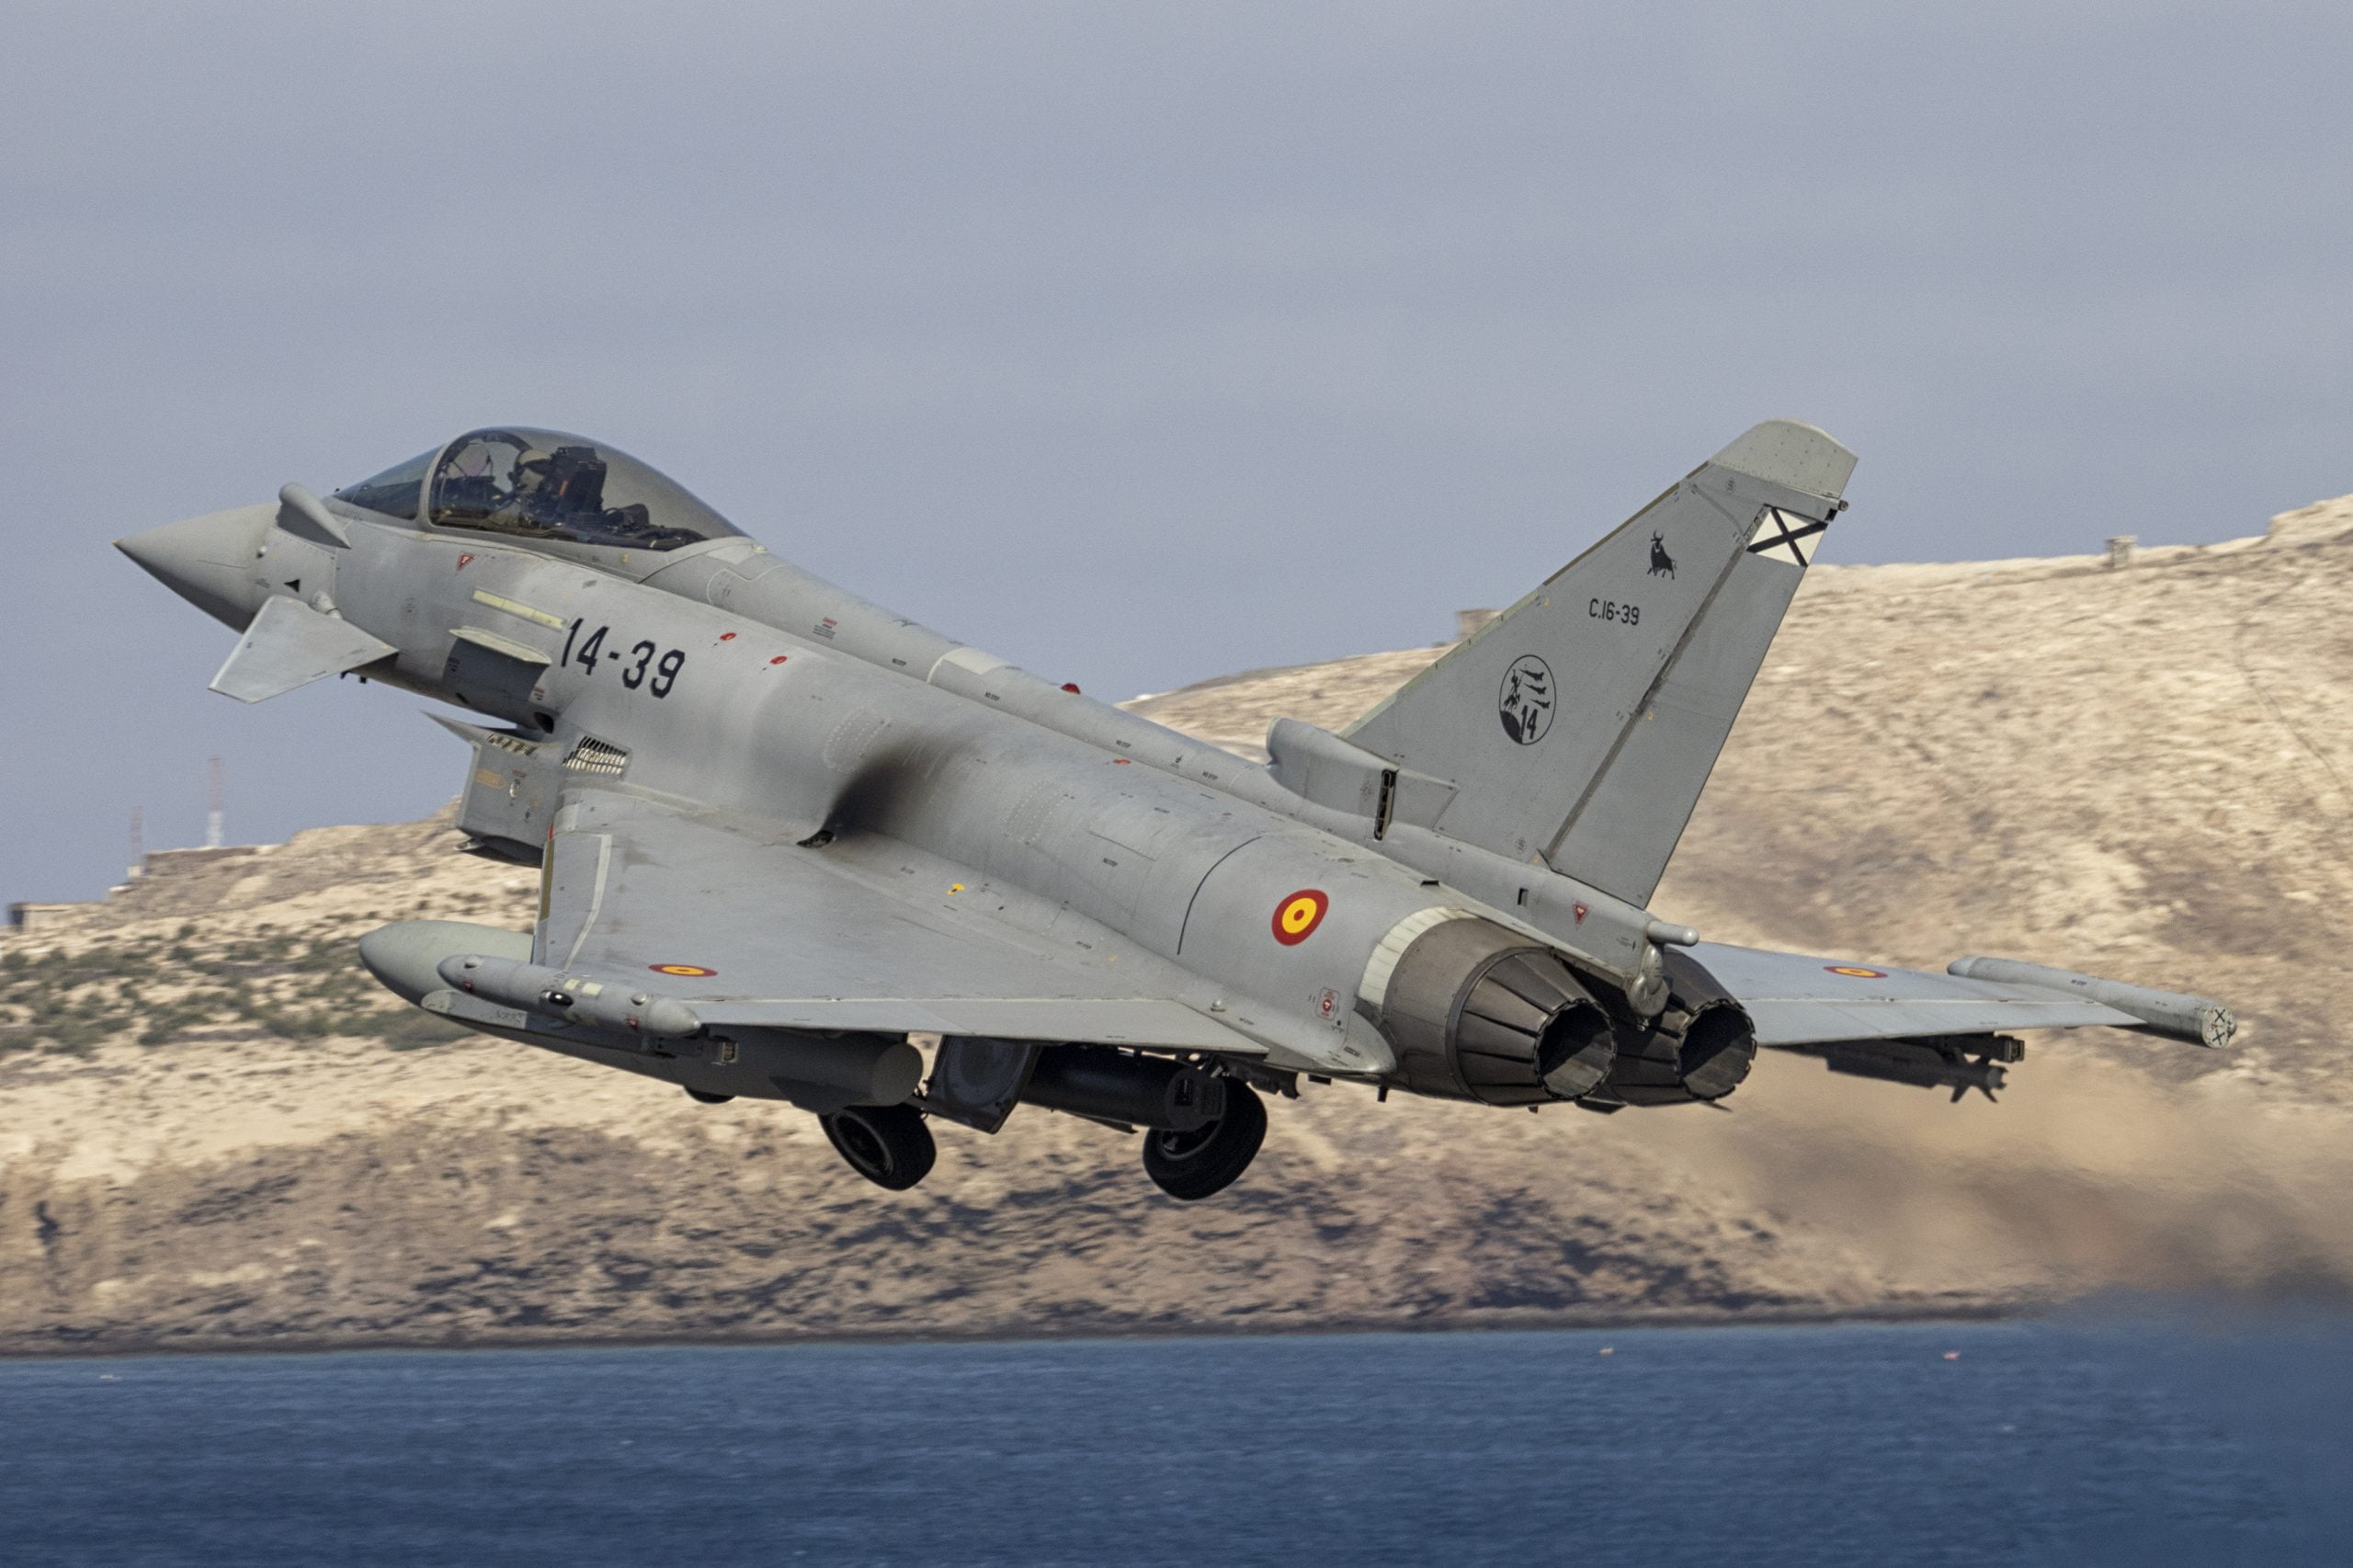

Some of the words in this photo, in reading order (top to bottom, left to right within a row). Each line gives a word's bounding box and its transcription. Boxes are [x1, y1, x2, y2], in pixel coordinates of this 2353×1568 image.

[1589, 597, 1640, 626] C.16-39
[561, 618, 686, 699] 14-39
[1520, 704, 1538, 740] 14
